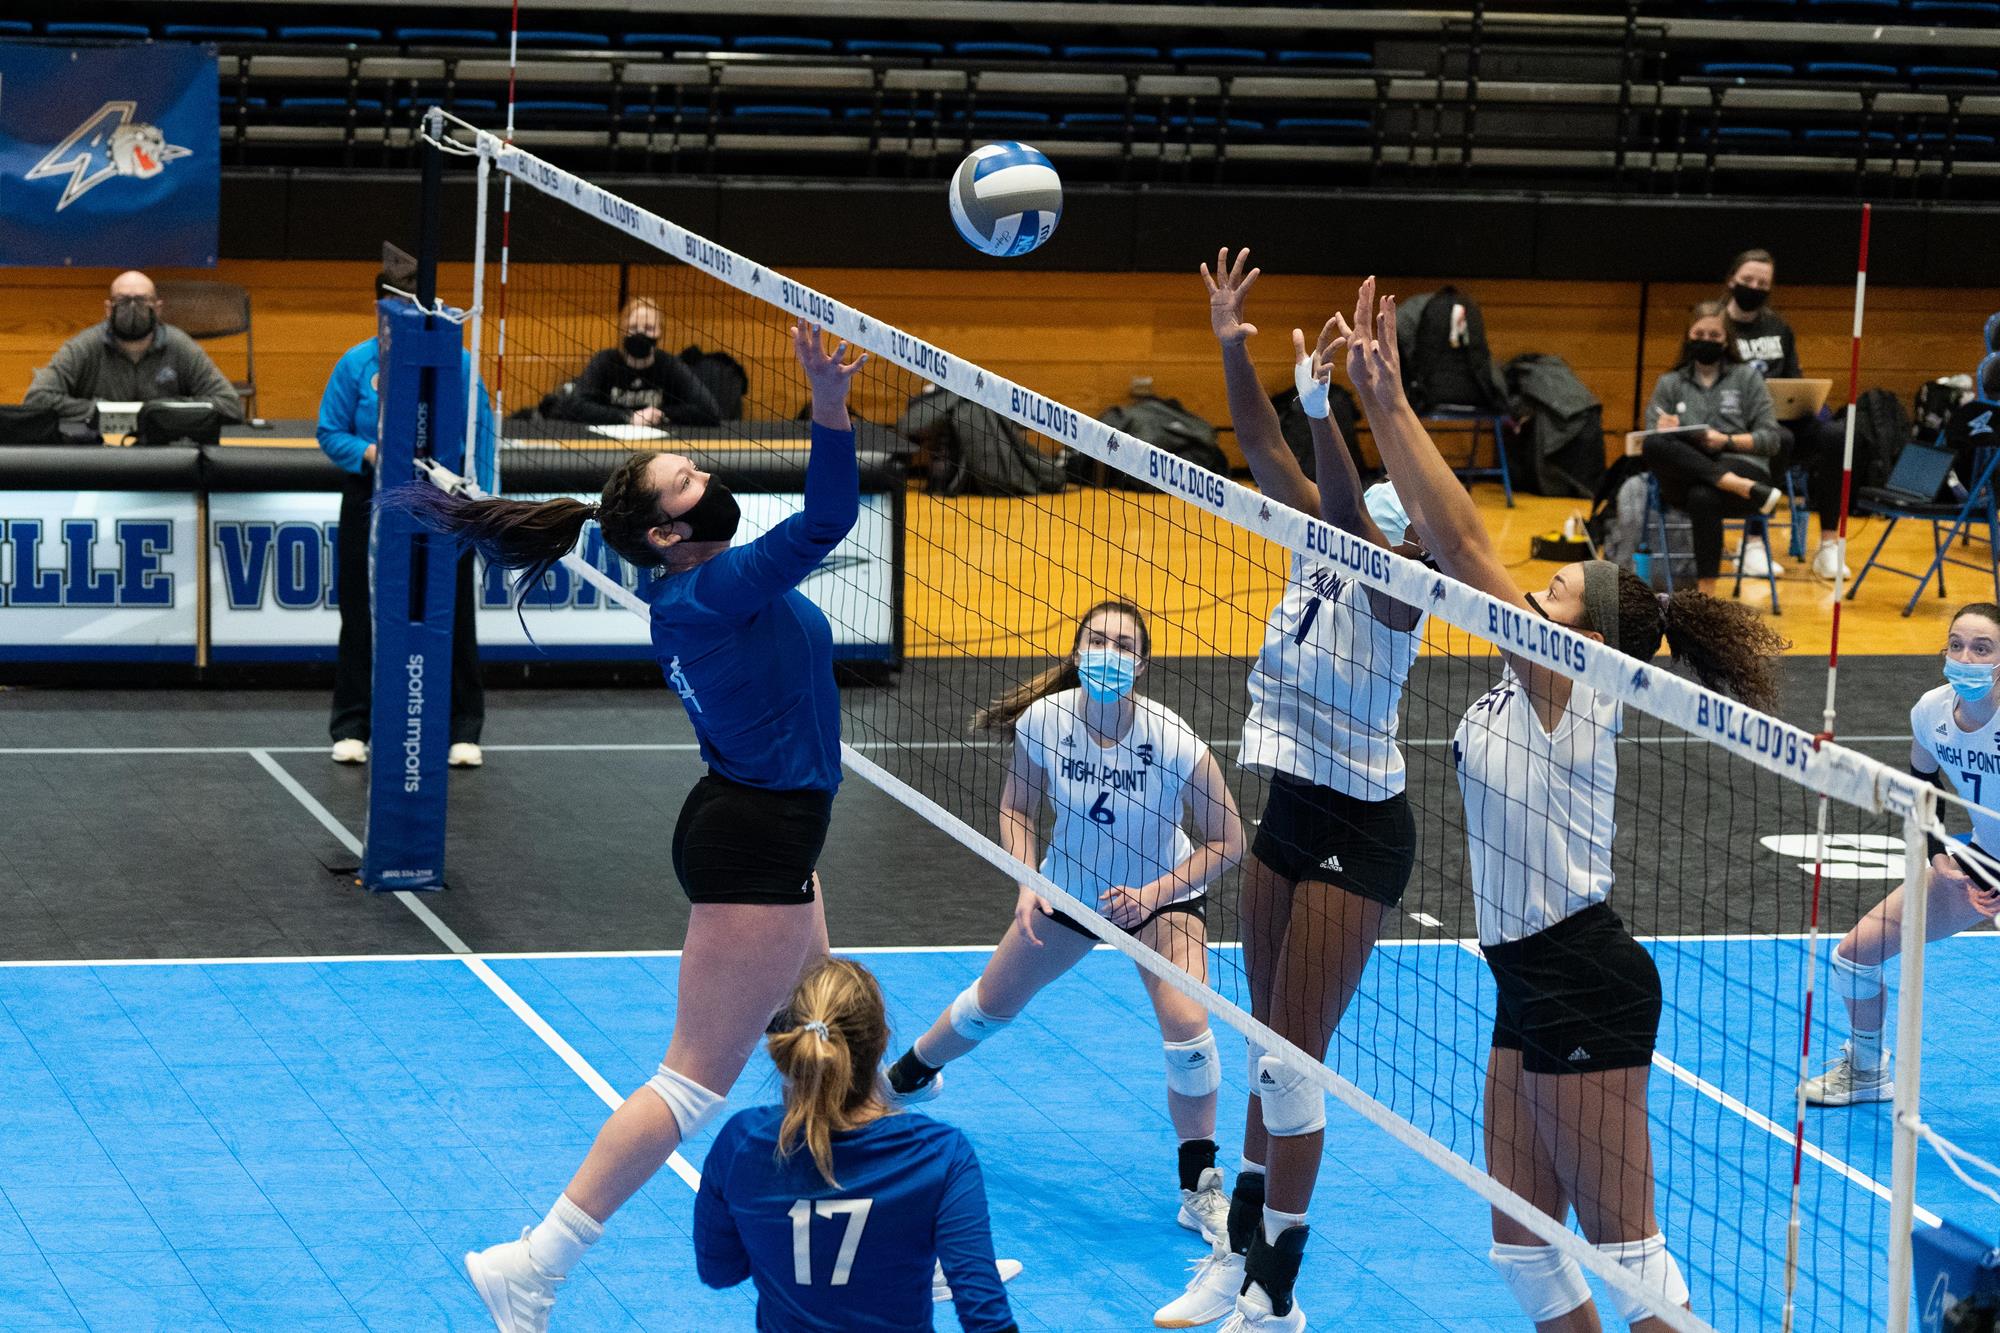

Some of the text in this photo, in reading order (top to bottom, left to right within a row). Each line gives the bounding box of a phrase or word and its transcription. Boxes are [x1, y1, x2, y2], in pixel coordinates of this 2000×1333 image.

[1012, 387, 1077, 440] BULLDOGS
[1150, 450, 1225, 508] BULLDOGS
[0, 518, 175, 609] LLE
[1306, 520, 1392, 585] BULLDOGS
[1294, 596, 1322, 646] 1
[1488, 602, 1587, 673] BULLDOGS
[406, 654, 424, 715] sports
[1698, 693, 1813, 772] BULLDOGS
[1935, 742, 2000, 775] HIGH POINT
[1061, 758, 1147, 792] HIGH POINT
[1961, 771, 1982, 805] 7
[1089, 791, 1116, 825] 6
[787, 1198, 873, 1286] 17
